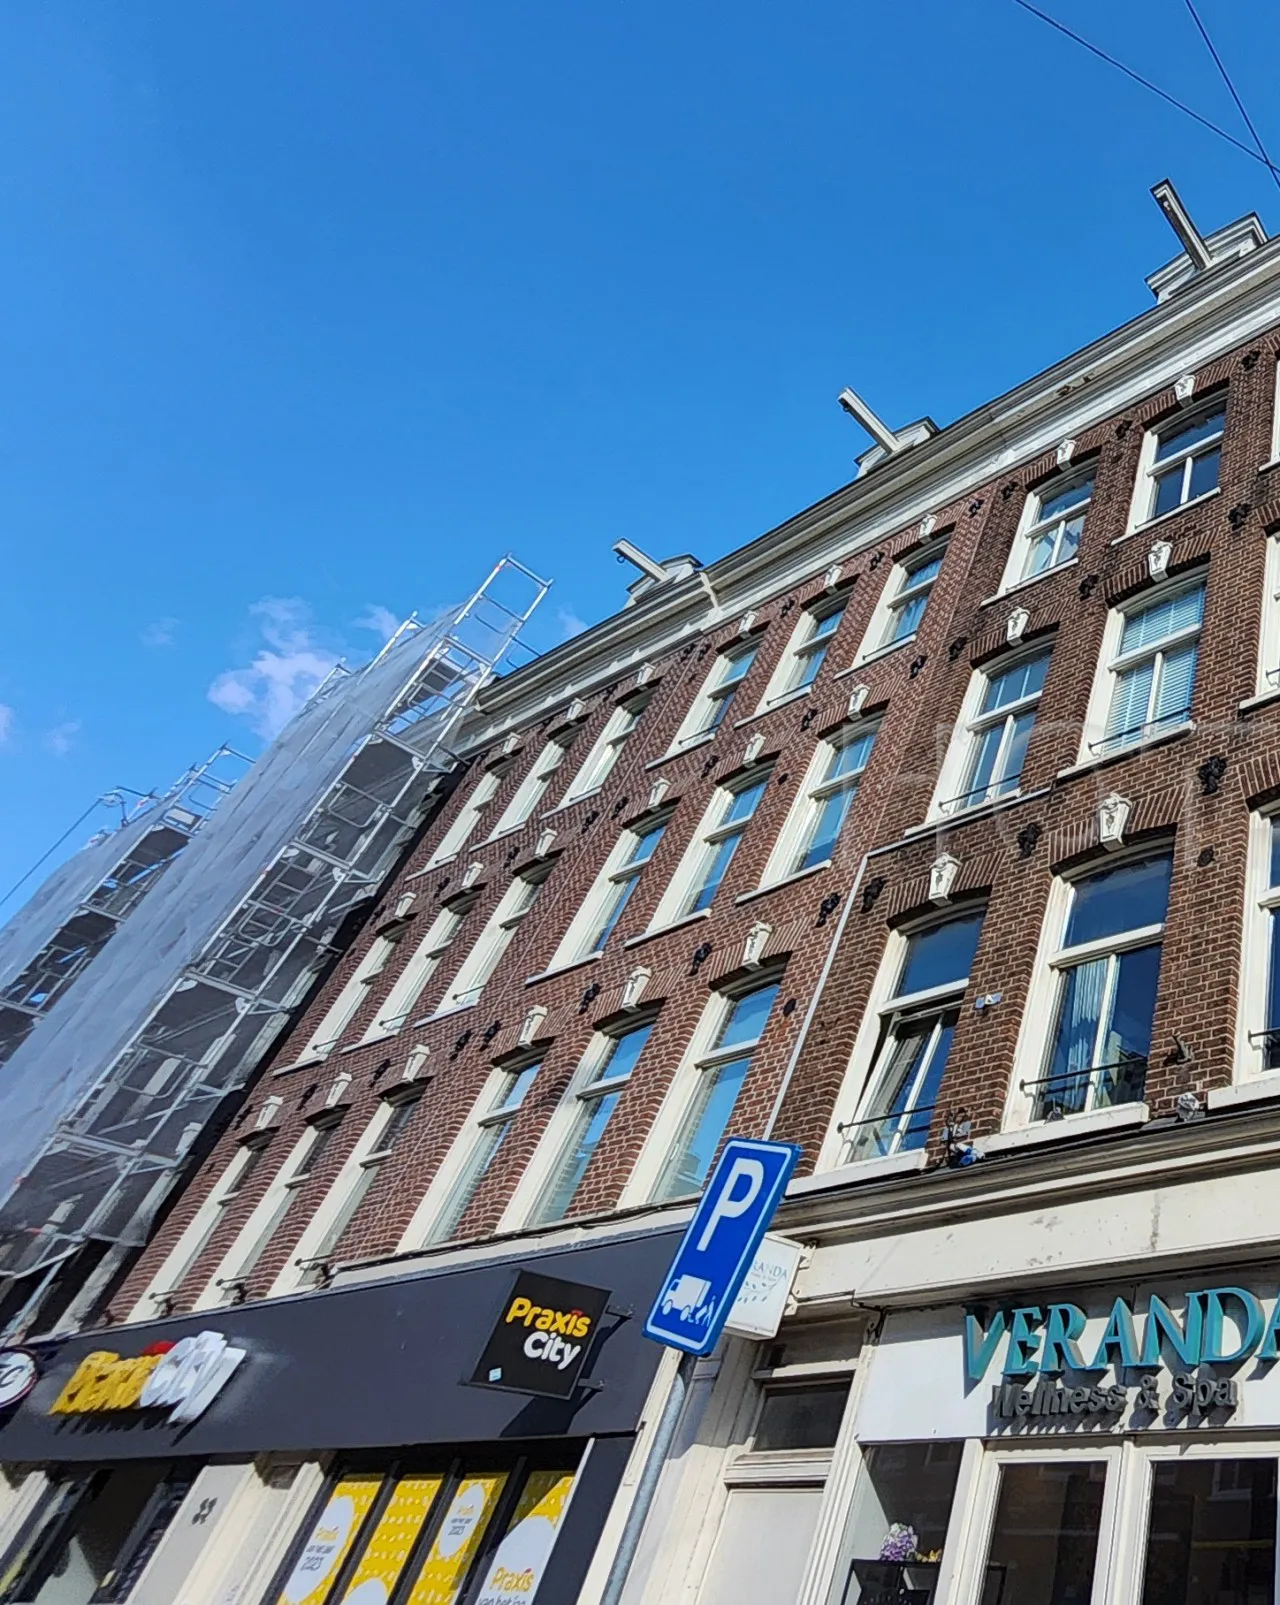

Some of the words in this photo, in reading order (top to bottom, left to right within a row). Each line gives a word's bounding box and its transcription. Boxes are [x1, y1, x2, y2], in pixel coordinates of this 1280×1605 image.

[696, 1157, 764, 1252] P
[505, 1297, 592, 1338] Praxis
[523, 1331, 582, 1370] City
[992, 1377, 1128, 1418] Wellness
[1137, 1374, 1161, 1412] &
[1172, 1371, 1239, 1416] Spa
[489, 1566, 536, 1592] Praxis
